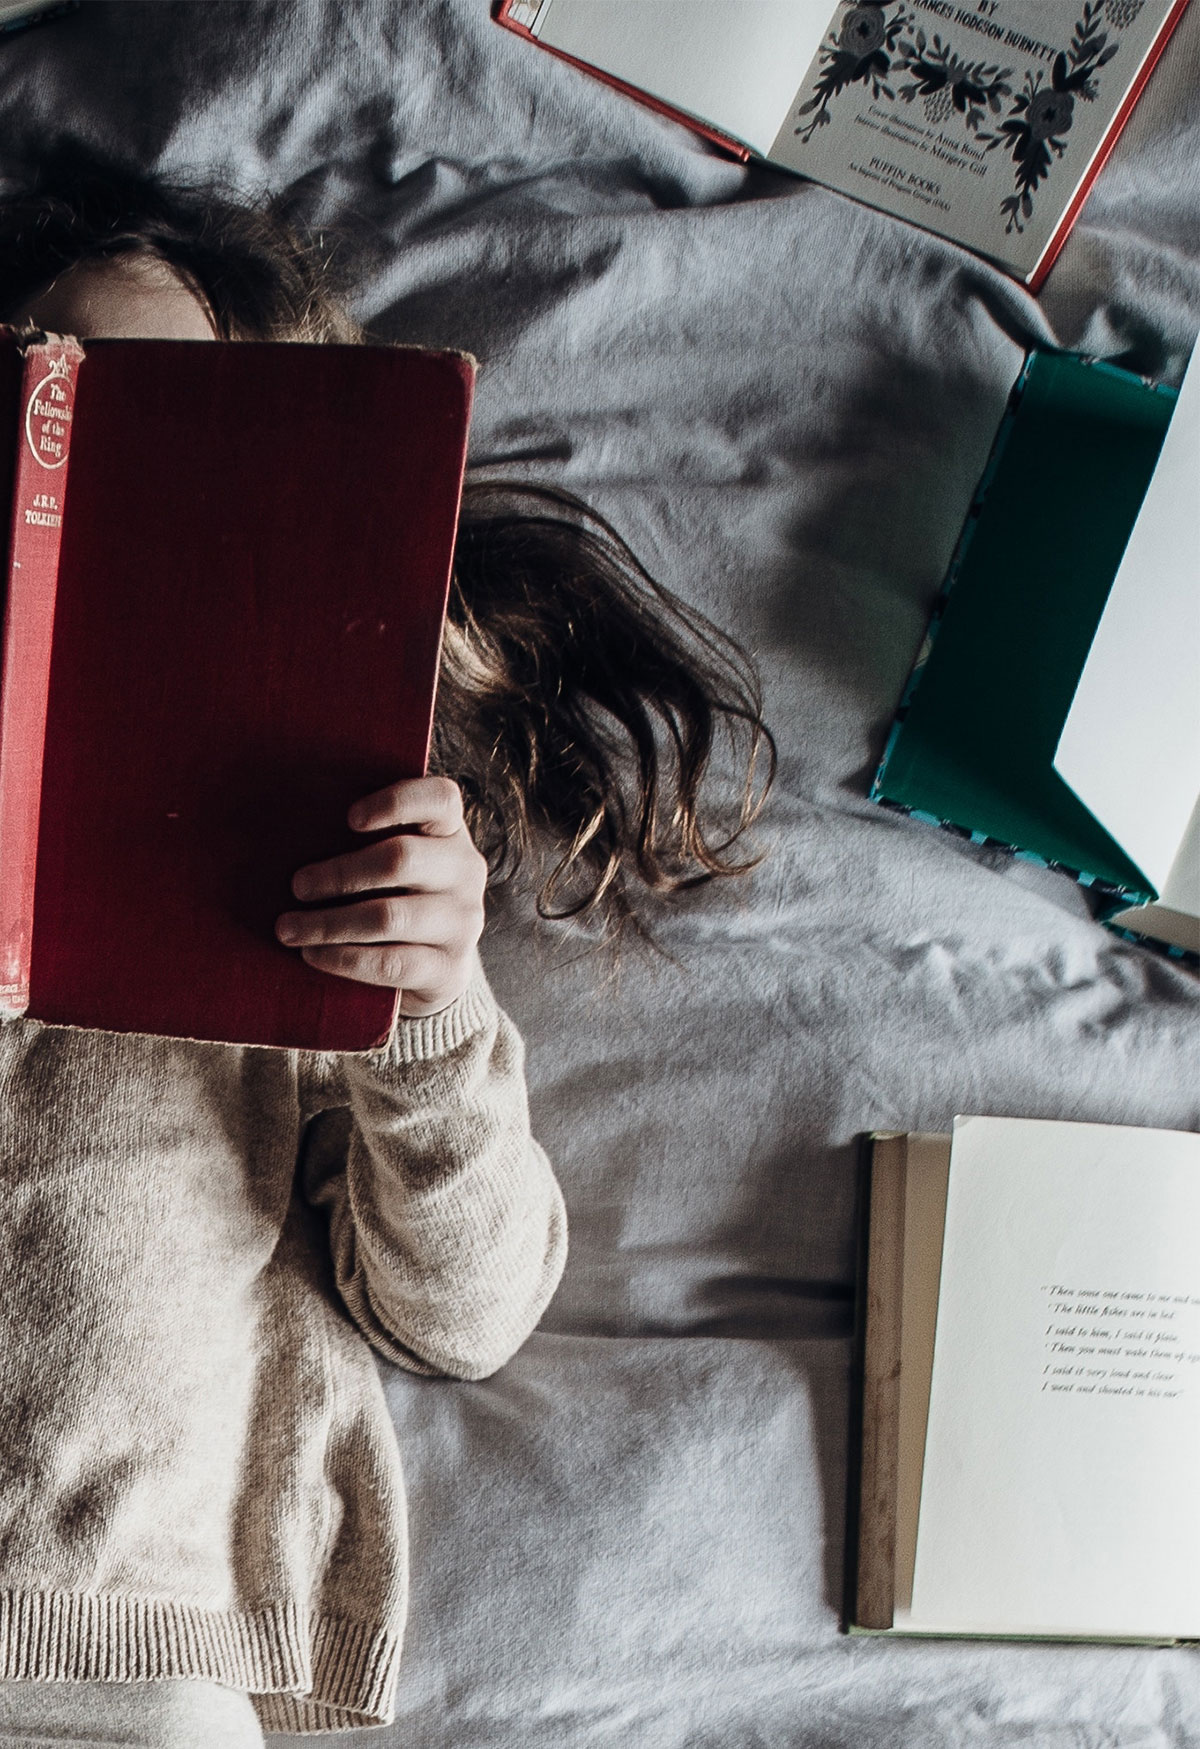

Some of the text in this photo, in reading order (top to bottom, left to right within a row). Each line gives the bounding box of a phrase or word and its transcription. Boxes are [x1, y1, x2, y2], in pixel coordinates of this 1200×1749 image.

[954, 9, 1005, 41] HODGSON
[1004, 29, 1058, 62] BURNETT
[936, 131, 960, 151] Anna
[961, 142, 986, 162] Bond
[931, 144, 968, 169] Margery
[969, 161, 988, 179] Gill
[869, 157, 940, 195] PUFFIN BOOKS
[50, 384, 66, 401] The
[42, 420, 65, 436] of the
[40, 435, 62, 457] Ring
[1102, 1291, 1120, 1299] one
[1074, 1304, 1099, 1315] little
[1045, 1324, 1054, 1336] I
[1055, 1325, 1076, 1336] said
[1078, 1327, 1087, 1337] to
[1041, 1380, 1049, 1392] I
